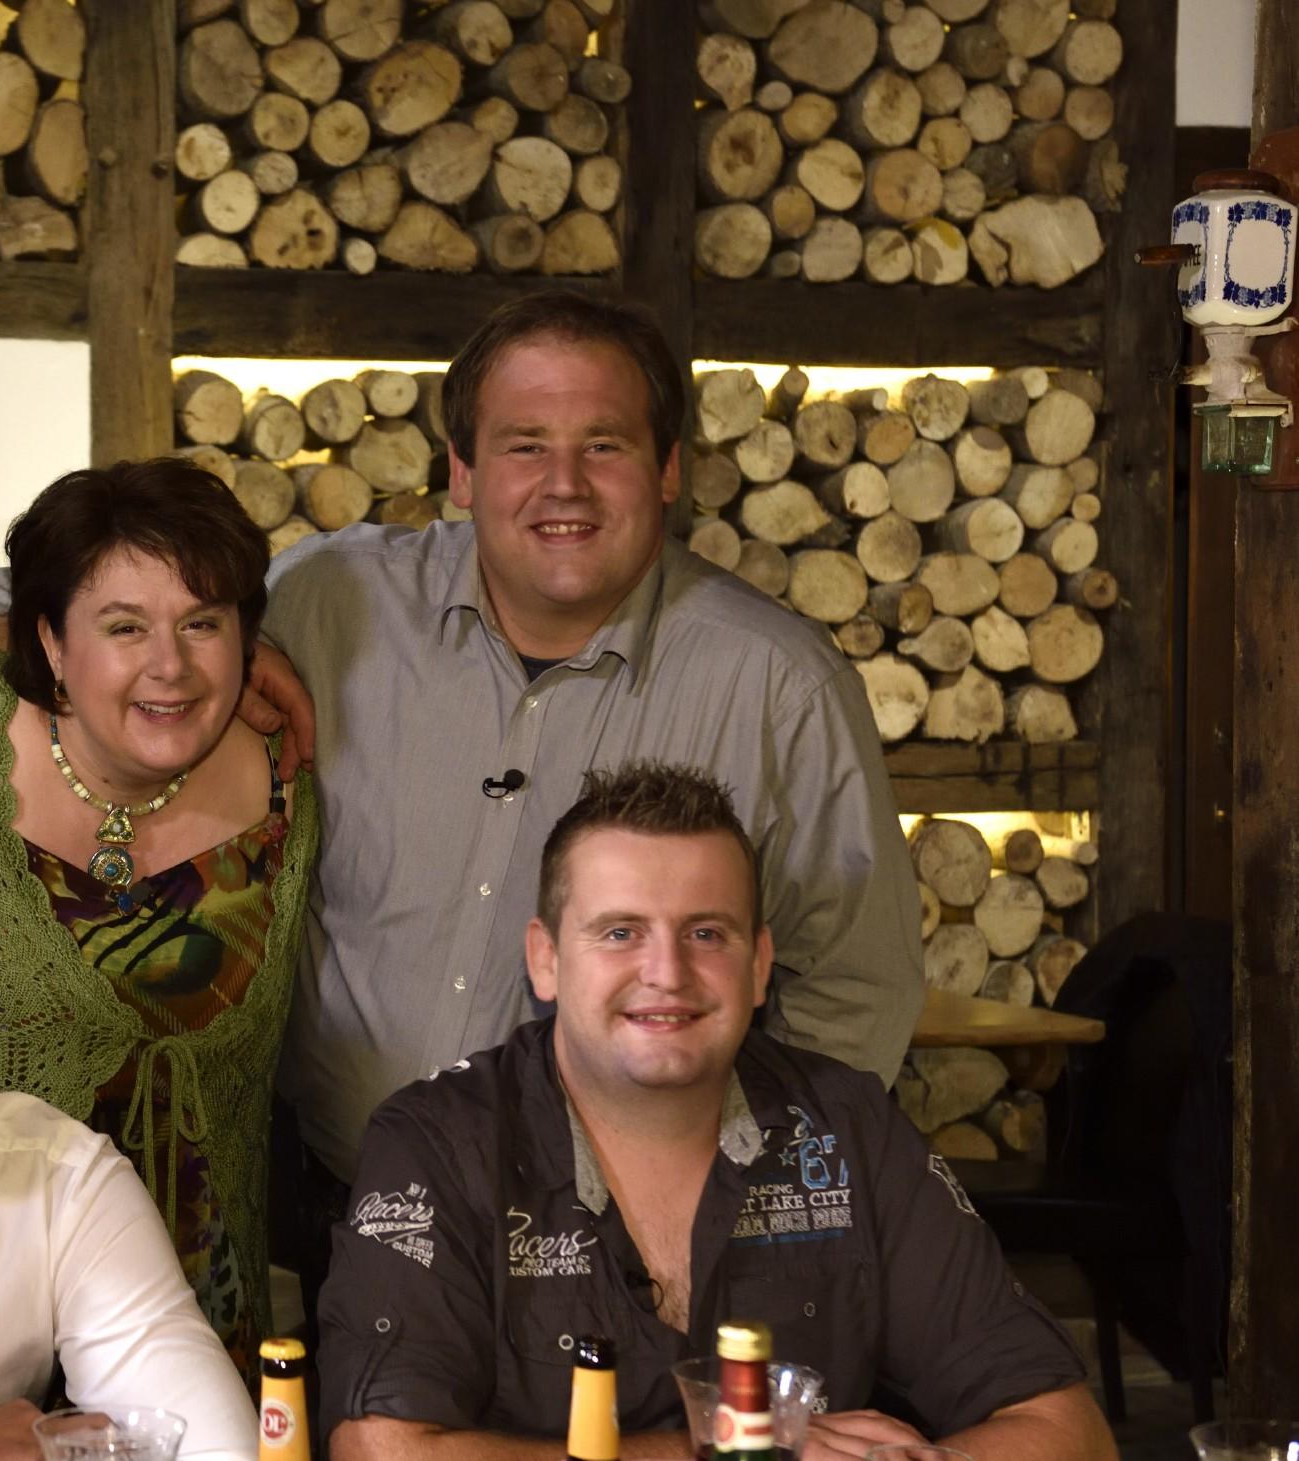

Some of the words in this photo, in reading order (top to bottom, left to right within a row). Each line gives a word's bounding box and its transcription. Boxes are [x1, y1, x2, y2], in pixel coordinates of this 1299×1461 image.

[748, 1183, 795, 1197] RACING
[760, 1194, 806, 1212] LAKE
[808, 1188, 852, 1207] CITY
[509, 1266, 554, 1277] USTOM
[558, 1263, 592, 1276] CARS
